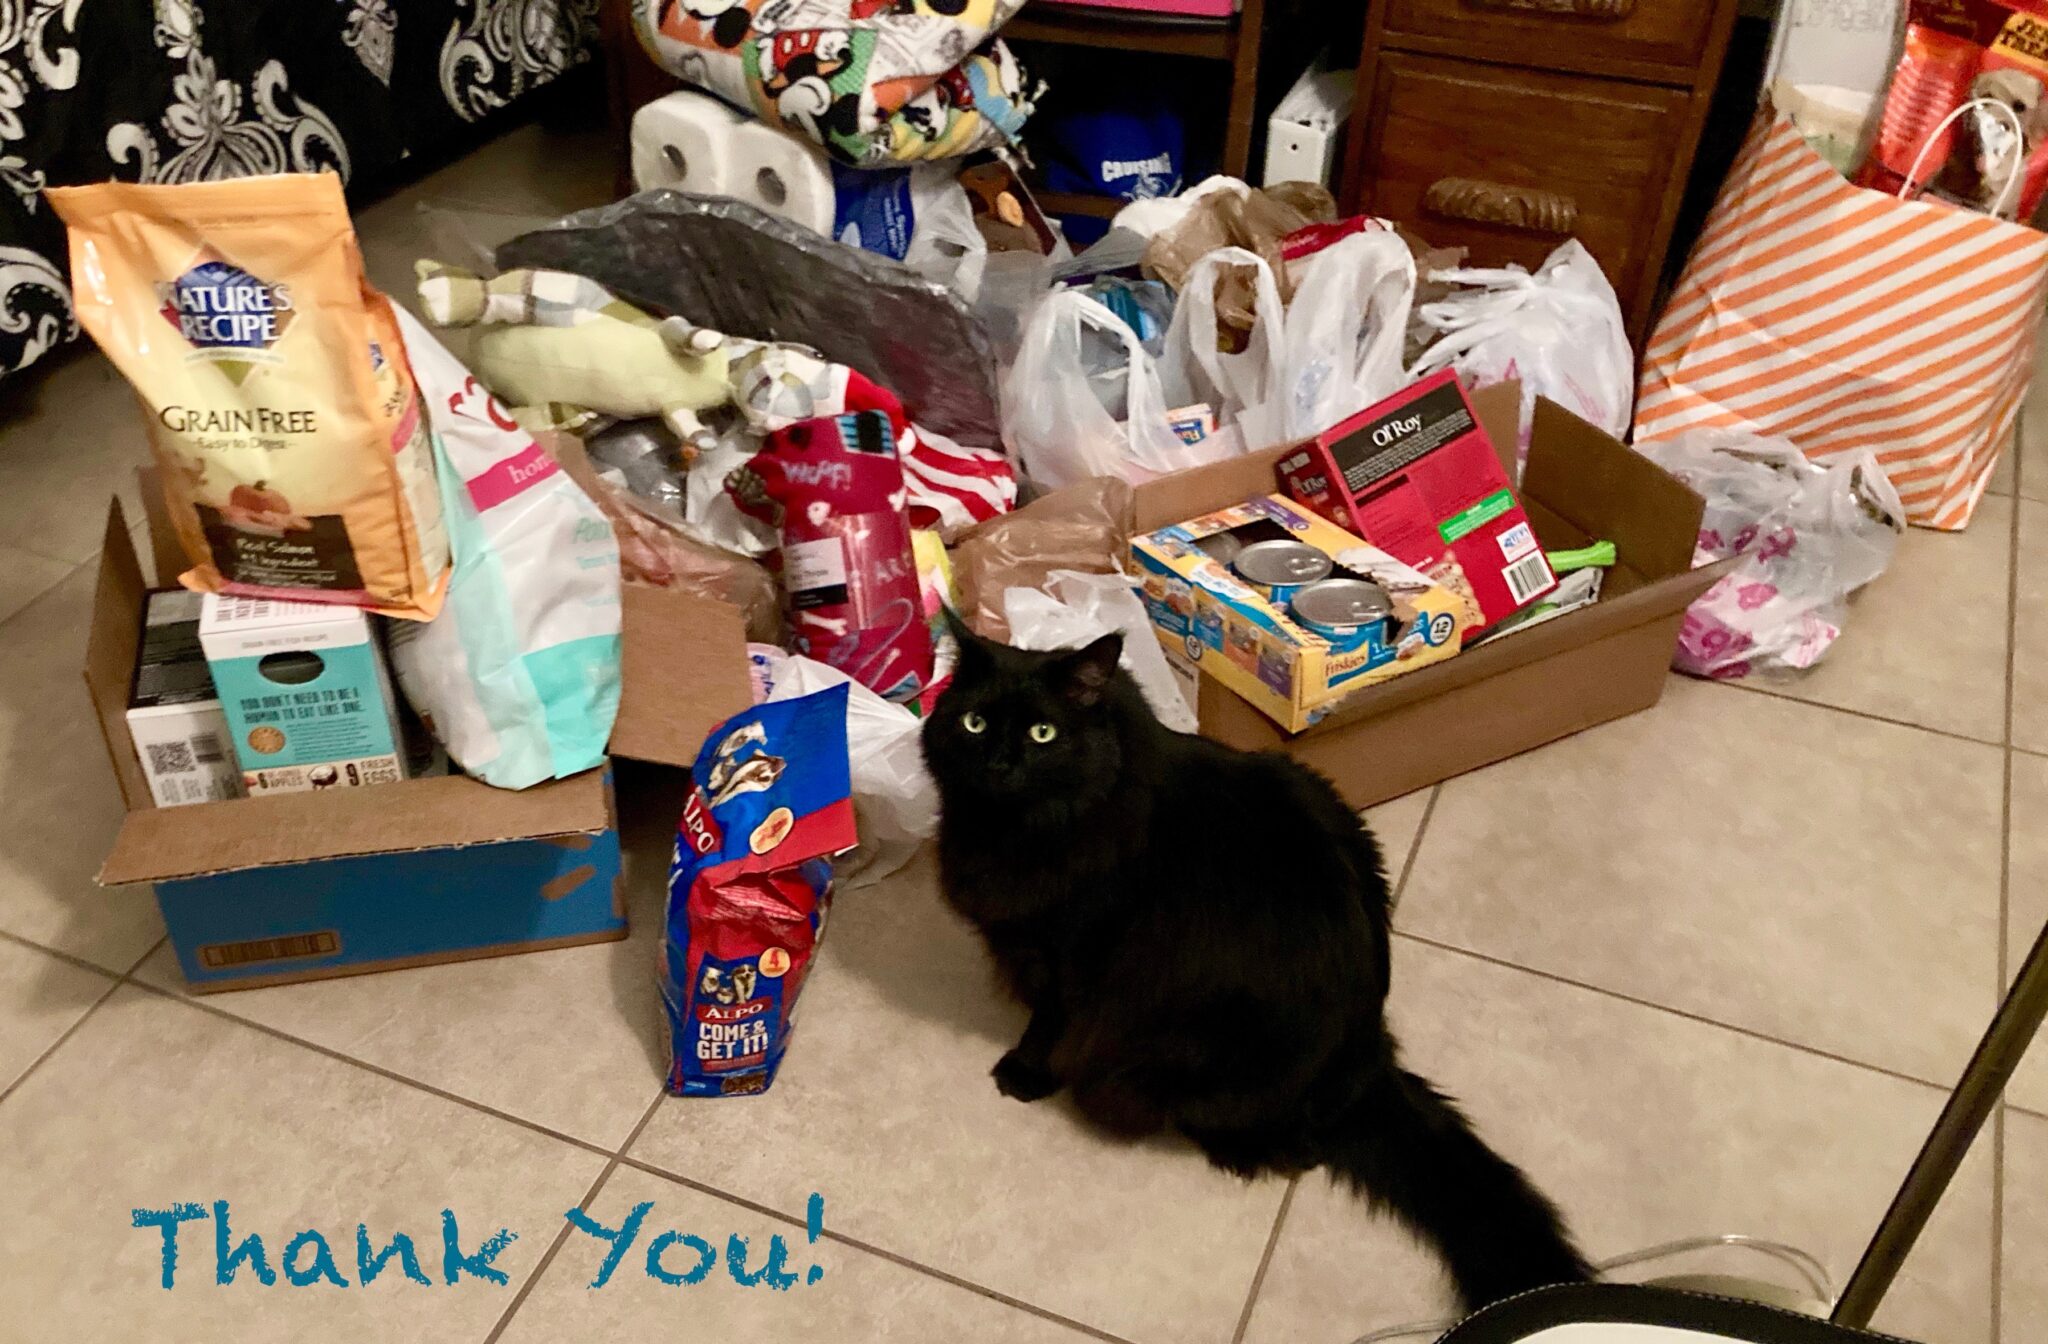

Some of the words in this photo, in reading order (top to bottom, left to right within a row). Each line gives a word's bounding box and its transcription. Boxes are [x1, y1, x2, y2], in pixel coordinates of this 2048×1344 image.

[179, 314, 281, 341] RECIPE
[159, 405, 252, 432] GRAIN
[256, 407, 318, 433] FREE
[1434, 621, 1450, 634] 12
[361, 757, 395, 769] FRESH
[345, 763, 360, 786] 9
[363, 768, 397, 786] EGGS
[705, 1004, 764, 1019] ALPO
[700, 1022, 750, 1042] COME
[753, 1020, 766, 1034] &
[697, 1040, 736, 1059] GET
[743, 1032, 768, 1055] IT!
